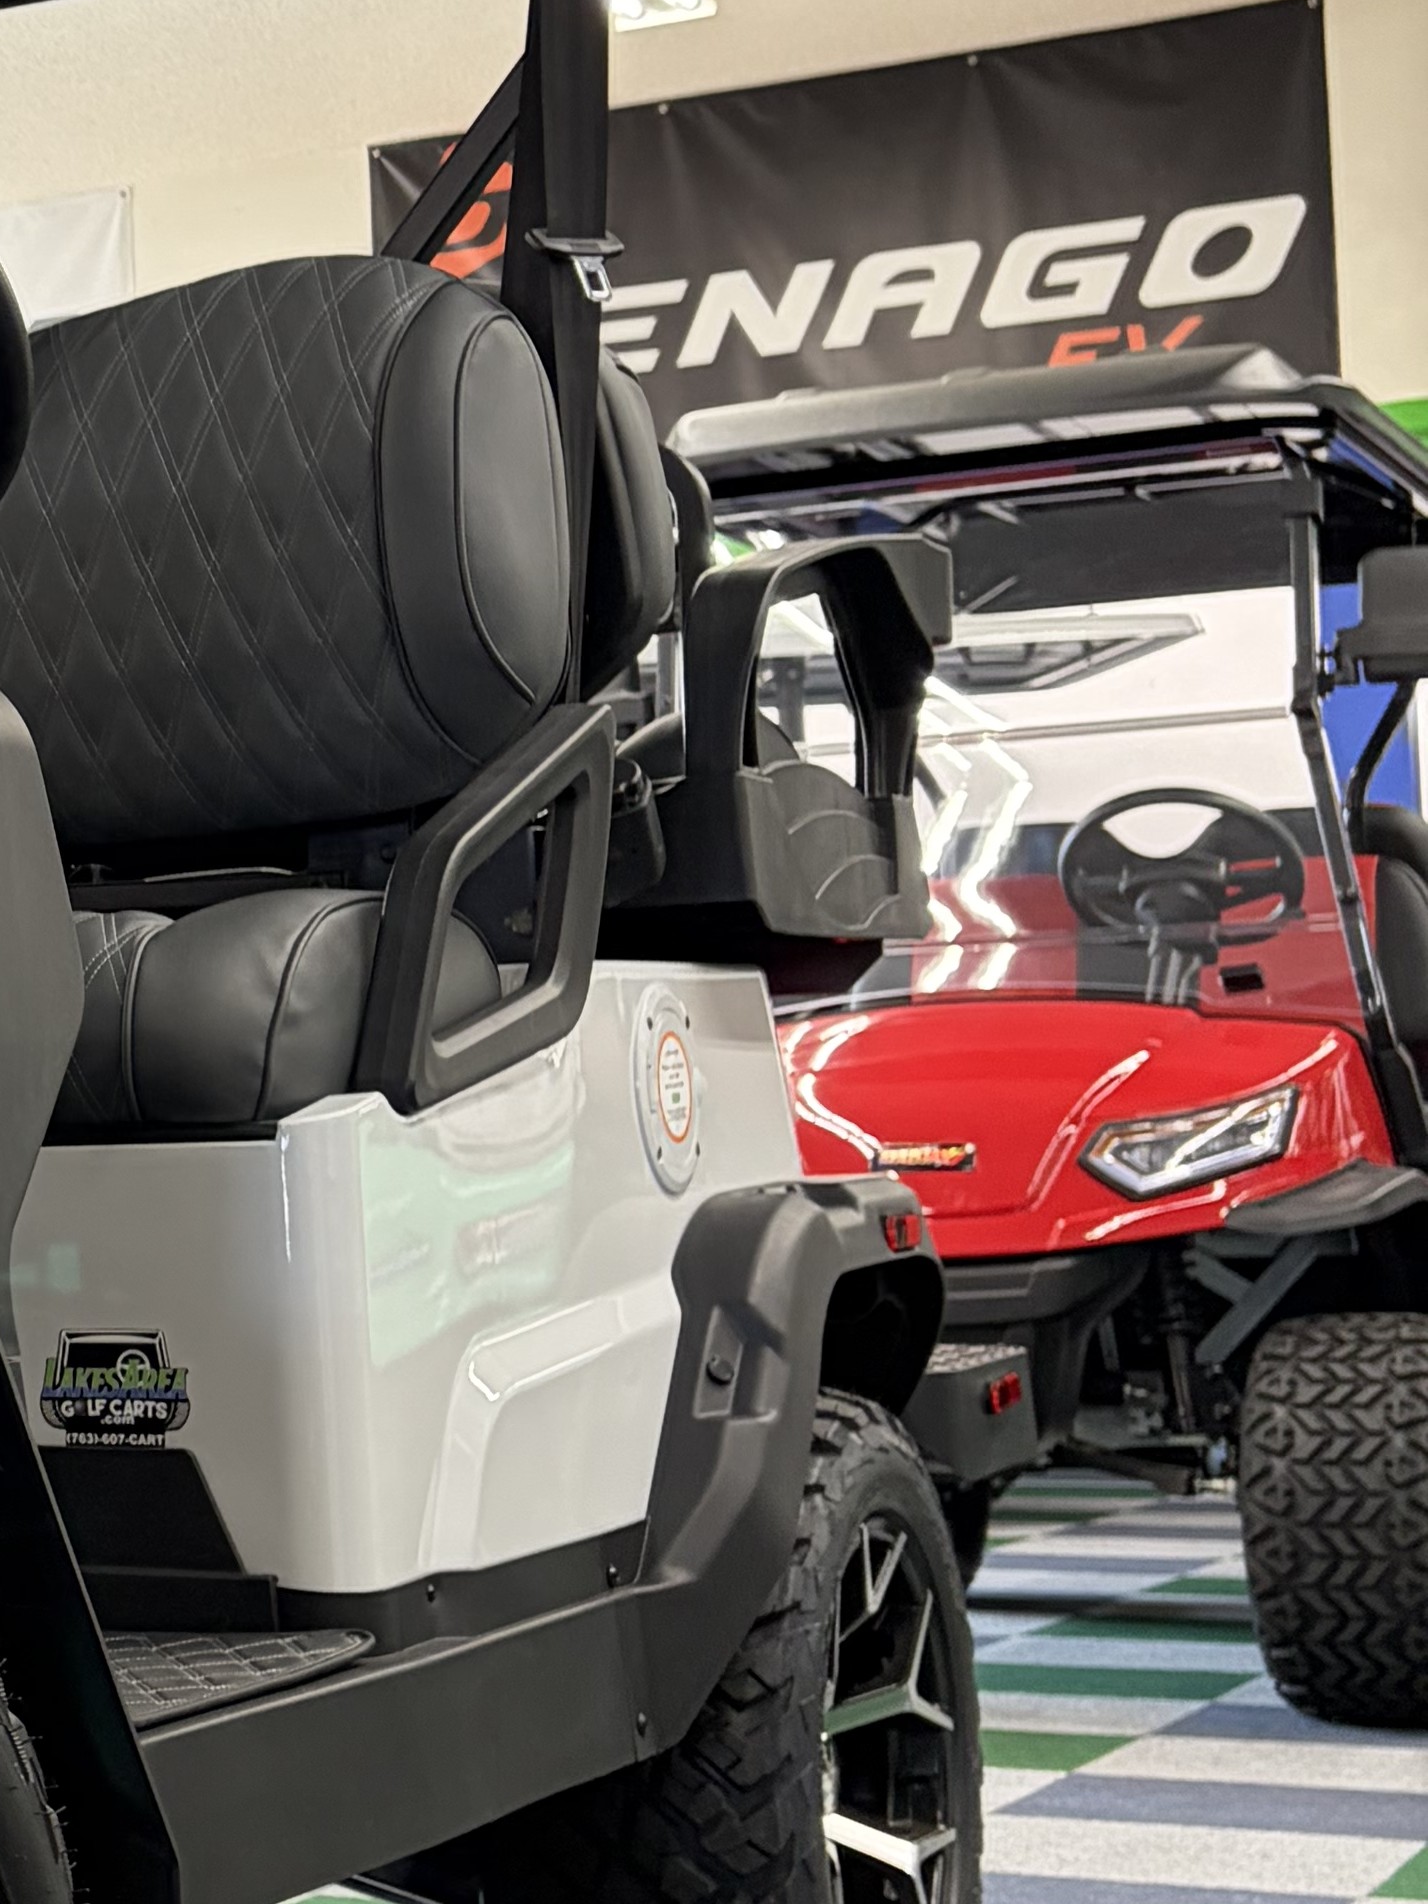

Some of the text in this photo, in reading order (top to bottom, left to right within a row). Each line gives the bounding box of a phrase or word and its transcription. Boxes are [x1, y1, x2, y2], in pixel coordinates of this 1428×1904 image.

[600, 193, 1308, 373] ENAGO
[41, 1358, 189, 1400] LAKES AREA
[100, 1415, 135, 1426] .com
[109, 1400, 168, 1419] CARTS
